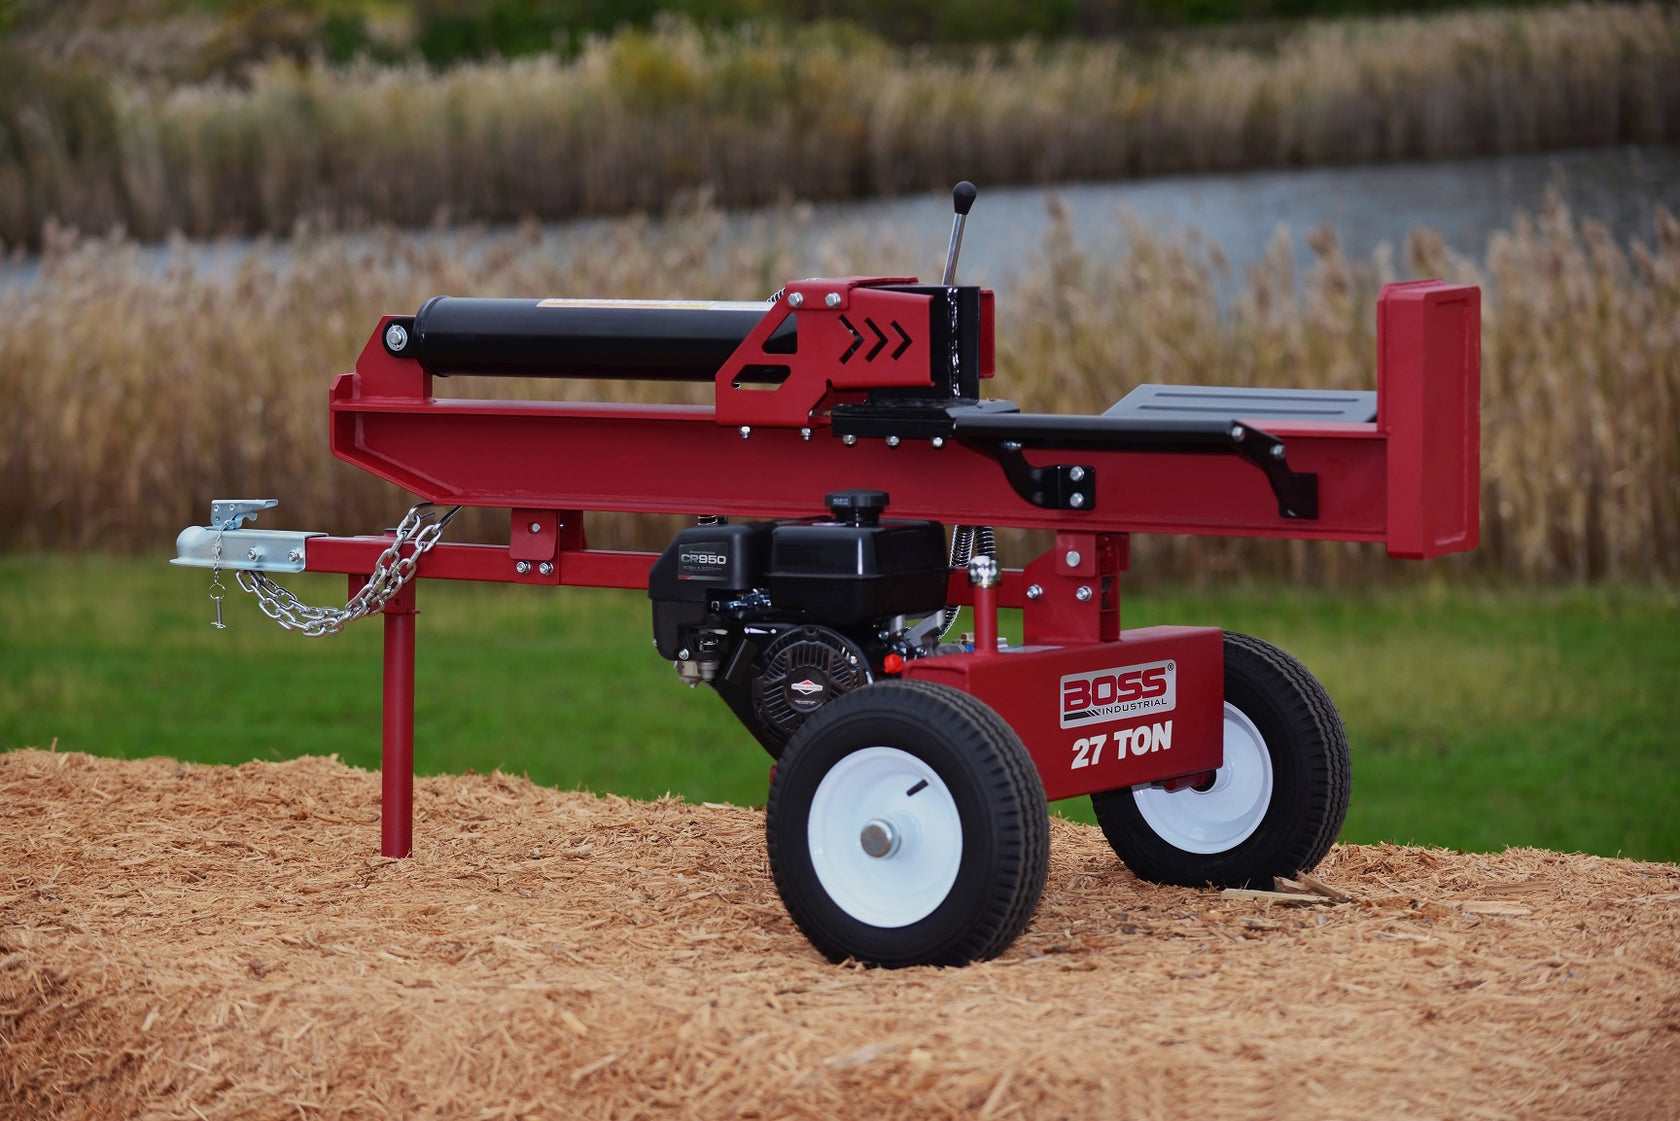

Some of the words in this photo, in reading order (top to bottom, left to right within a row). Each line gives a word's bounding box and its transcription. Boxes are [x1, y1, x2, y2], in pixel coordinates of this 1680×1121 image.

[681, 554, 727, 565] CR950
[1102, 698, 1168, 715] INDUSTRIAL
[1071, 734, 1107, 770] 27
[1113, 720, 1173, 760] TON
